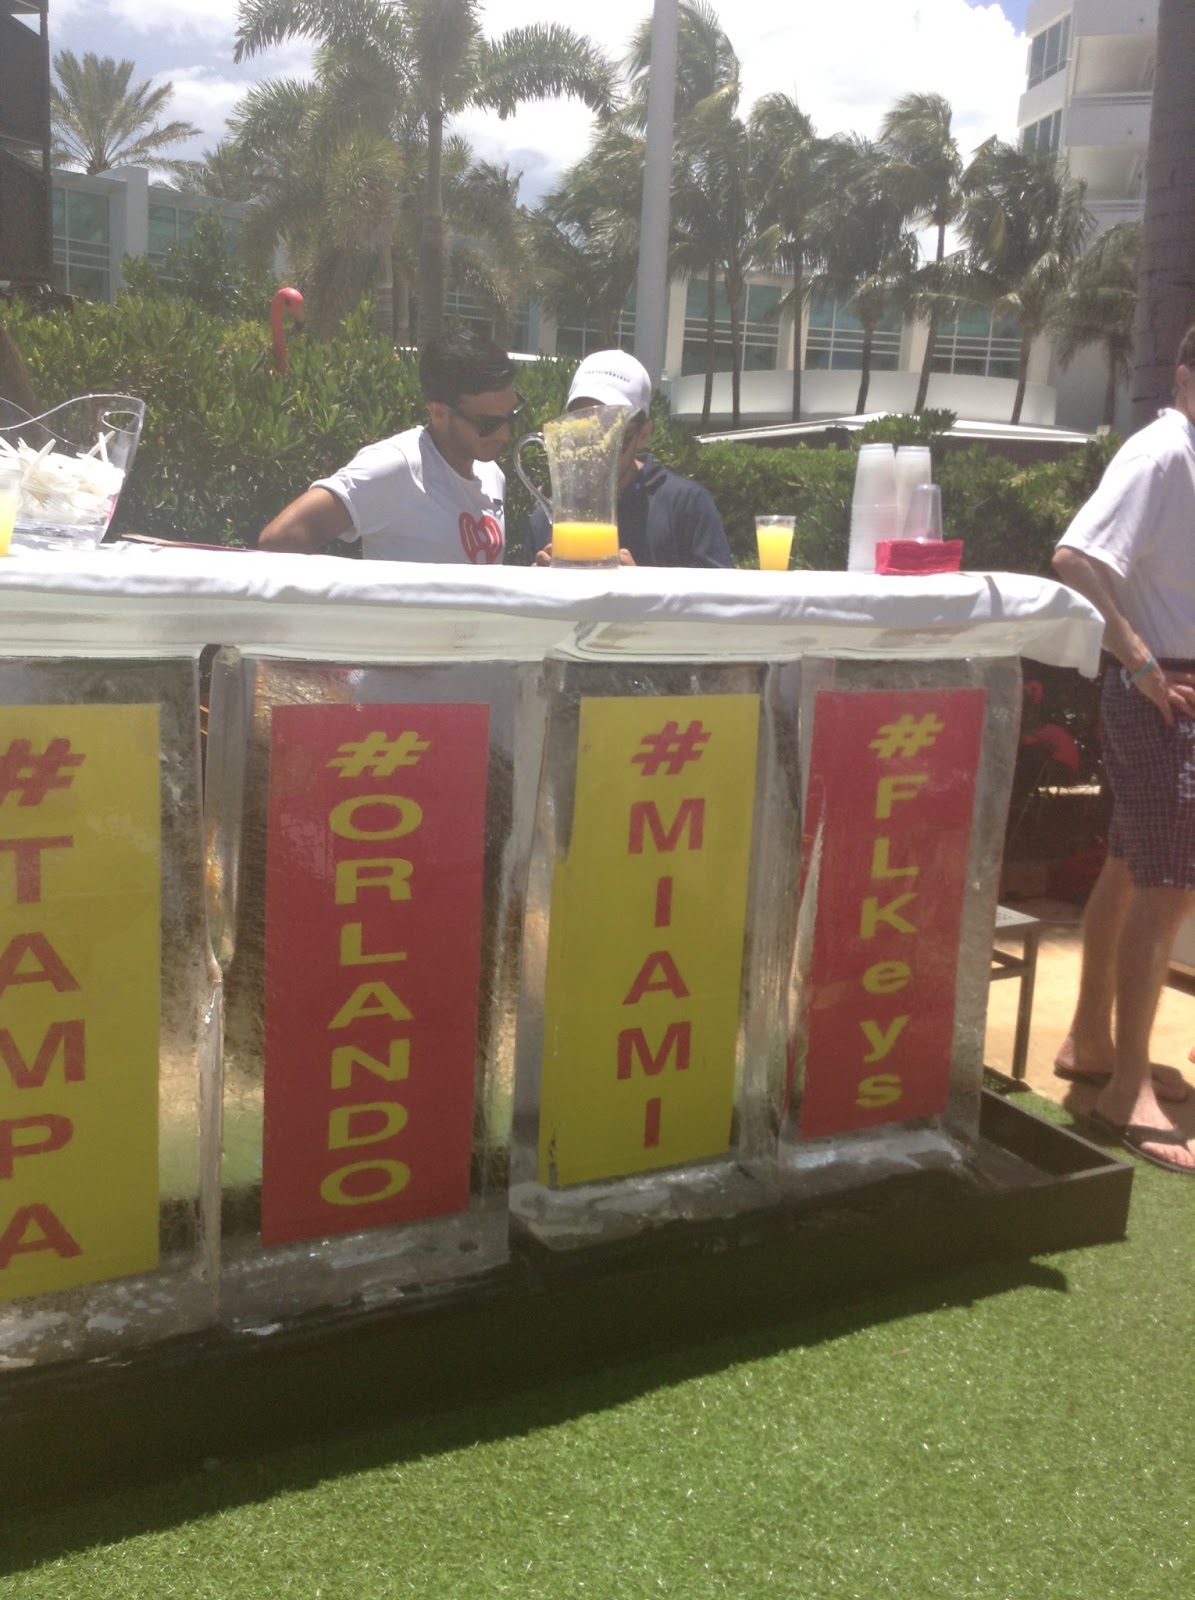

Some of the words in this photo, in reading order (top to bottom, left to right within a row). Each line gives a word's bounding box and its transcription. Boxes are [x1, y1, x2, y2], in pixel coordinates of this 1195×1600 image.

[0, 738, 86, 1268] #TAMPA
[319, 730, 430, 1206] #ORLANDO
[616, 719, 712, 1148] #MIAMI
[855, 712, 944, 1108] #FLKeys
